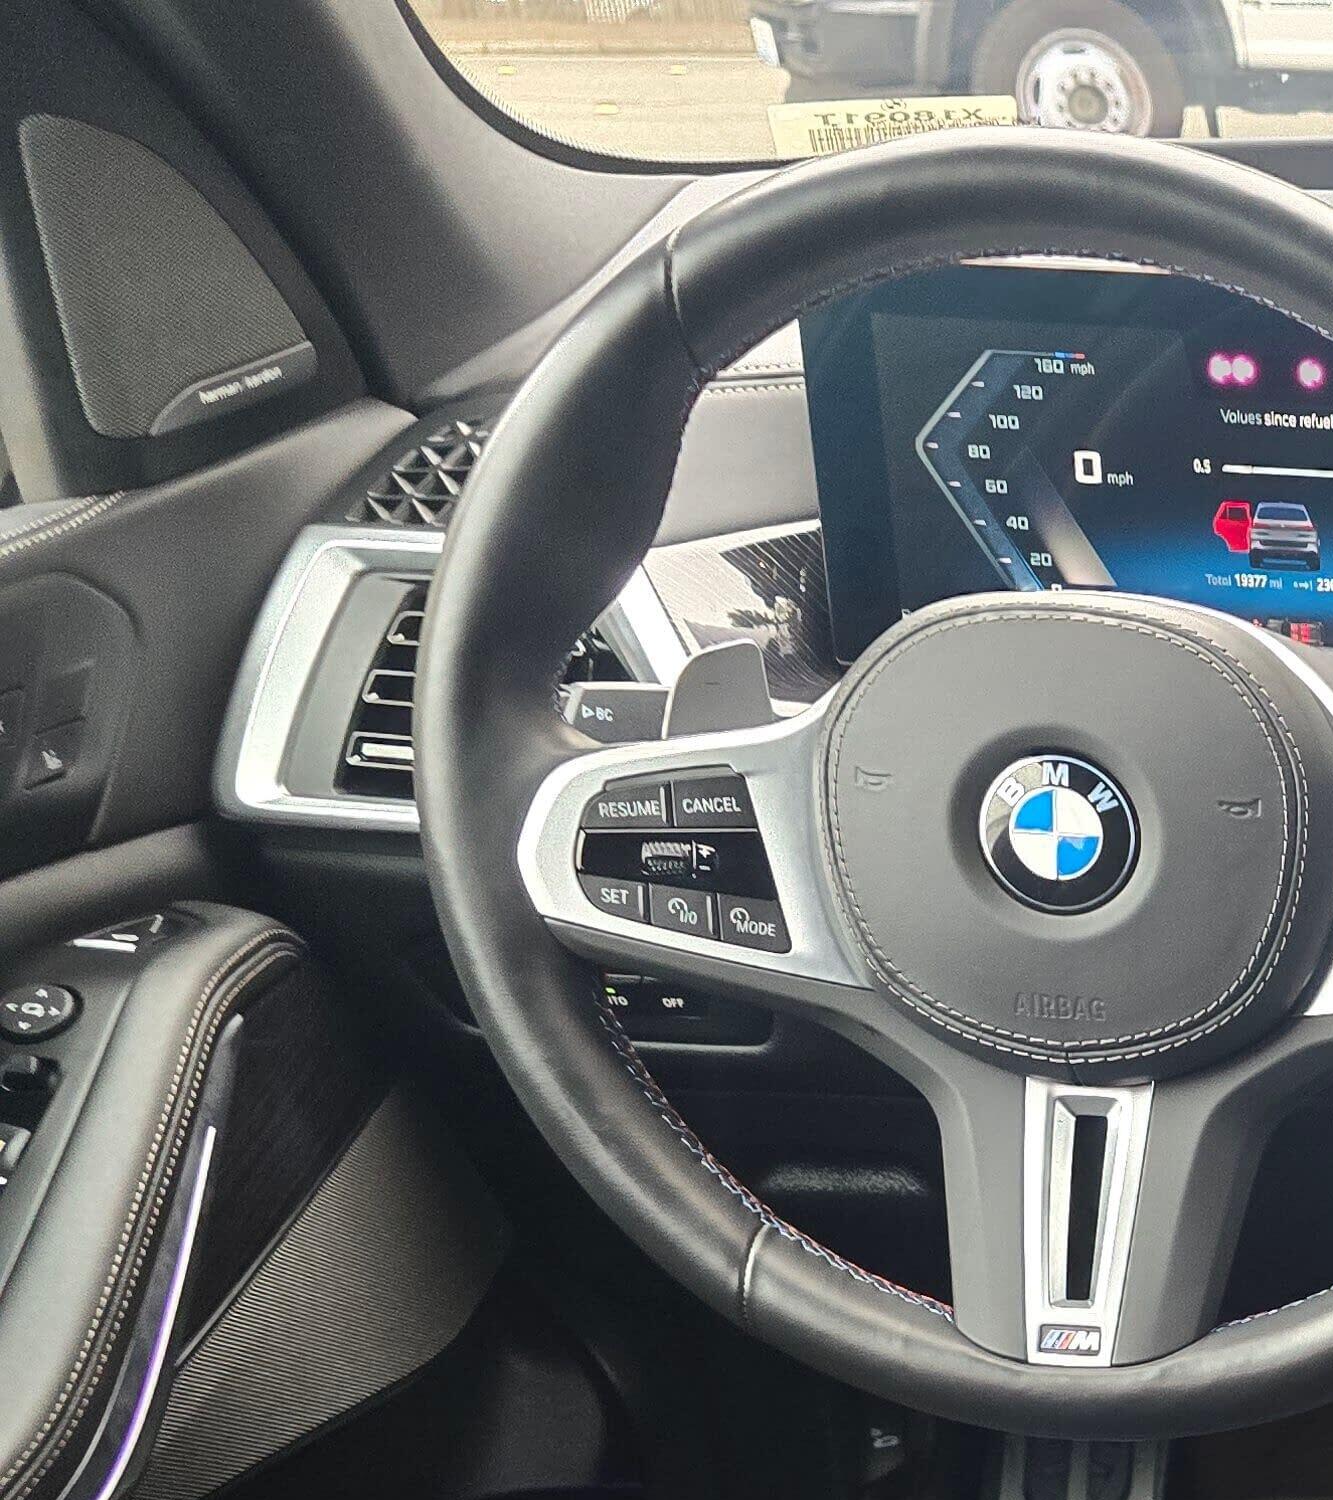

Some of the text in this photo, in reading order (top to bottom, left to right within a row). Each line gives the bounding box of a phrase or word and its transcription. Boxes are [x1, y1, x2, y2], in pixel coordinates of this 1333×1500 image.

[1070, 361, 1095, 377] mph
[1013, 384, 1043, 400] 120
[989, 414, 1020, 430] 100
[1220, 408, 1262, 426] Values
[1264, 411, 1297, 428] since
[967, 444, 990, 460] 80
[1073, 450, 1134, 486] 0 mph
[1193, 458, 1211, 474] 0.5
[985, 479, 1008, 494] 60
[1006, 516, 1029, 531] 40
[1030, 553, 1053, 566] 20
[1205, 573, 1232, 588] Total
[1234, 573, 1269, 588] 19377
[997, 760, 1119, 813] BMW
[599, 796, 742, 818] RESUME CANCEL
[600, 888, 629, 905] SET
[736, 918, 777, 938] MODE
[1014, 990, 1106, 1022] AIRBAG
